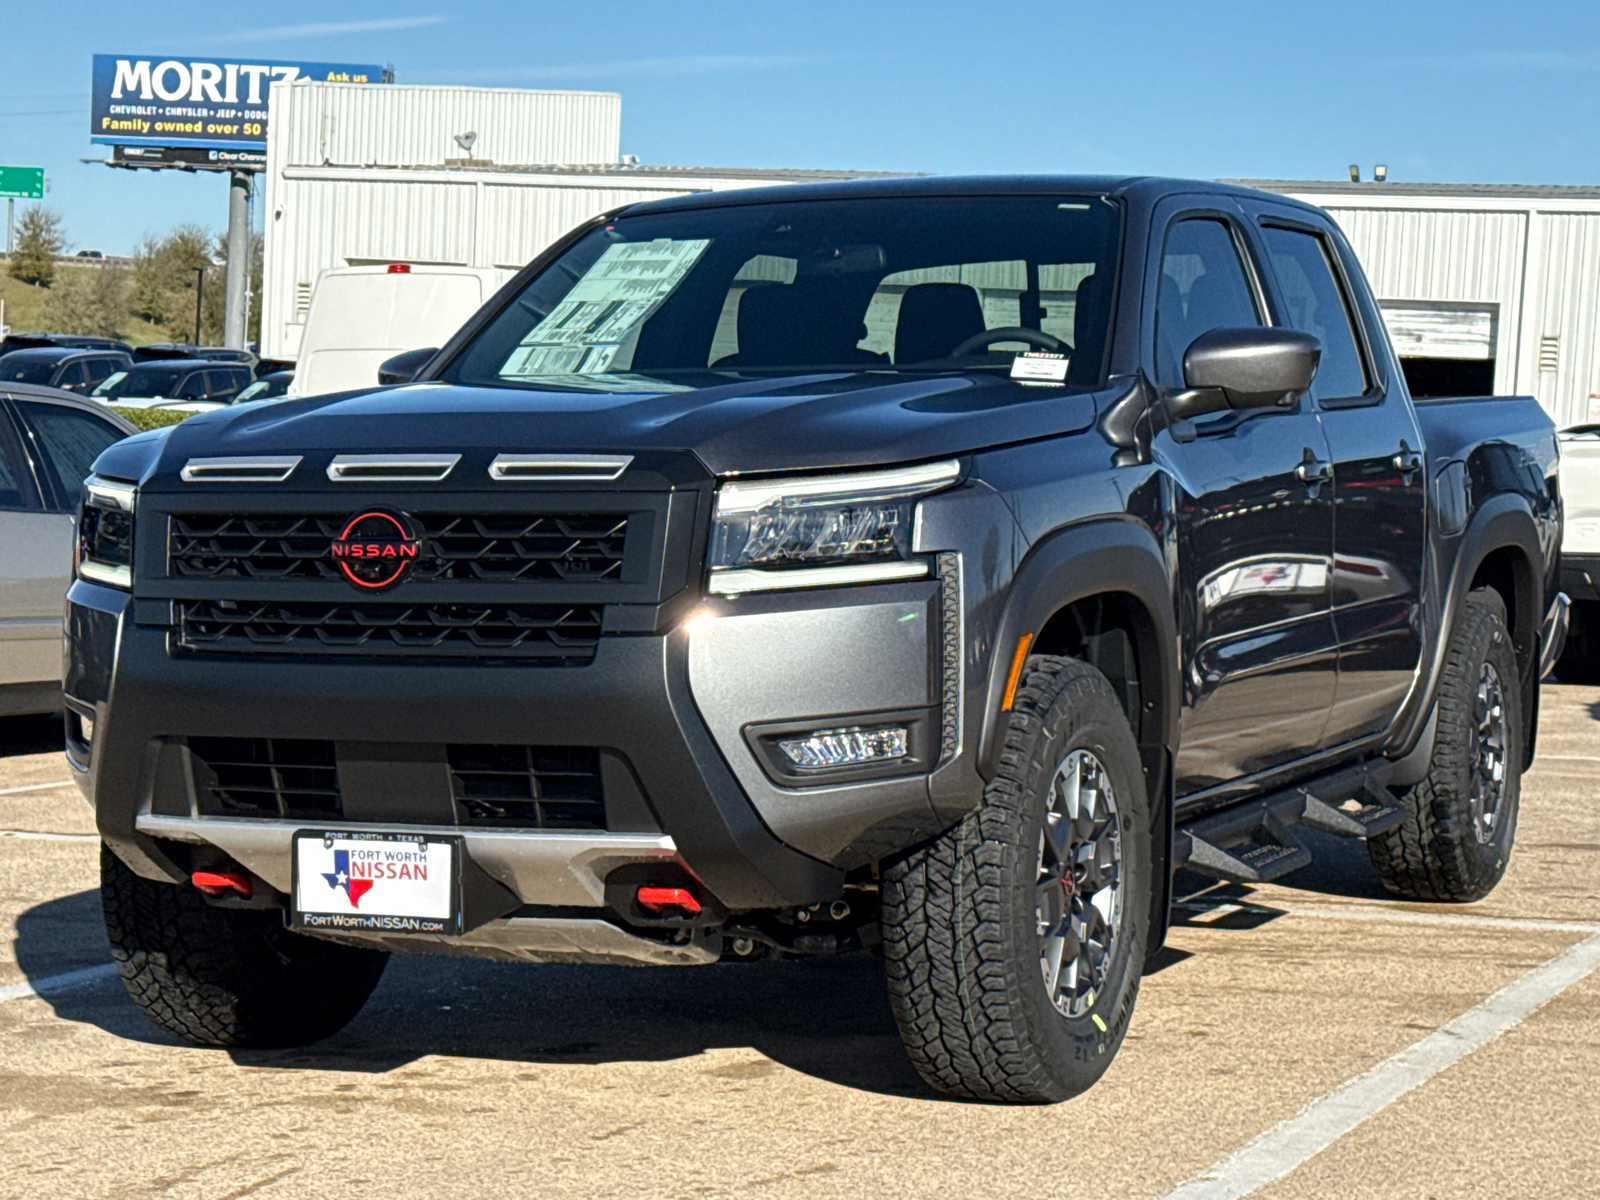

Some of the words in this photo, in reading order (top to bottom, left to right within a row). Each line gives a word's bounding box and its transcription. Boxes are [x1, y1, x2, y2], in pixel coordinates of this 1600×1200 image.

[327, 71, 350, 82] Ask
[352, 73, 368, 83] us
[109, 104, 157, 116] CHEVROLET
[165, 106, 208, 118] CHRYSLER
[215, 108, 237, 119] JEEP
[244, 109, 268, 120] DODG
[102, 117, 151, 134] Family
[154, 120, 203, 133] owned
[206, 123, 240, 135] over
[243, 122, 262, 135] 50
[238, 152, 268, 161] Channe
[331, 543, 416, 557] NISSAN
[324, 831, 349, 840] FORT
[351, 833, 383, 841] WORTH
[396, 834, 425, 843] TEXAS
[351, 850, 381, 861] FORT
[384, 850, 428, 863] WORTH
[351, 861, 428, 881] NISSAN
